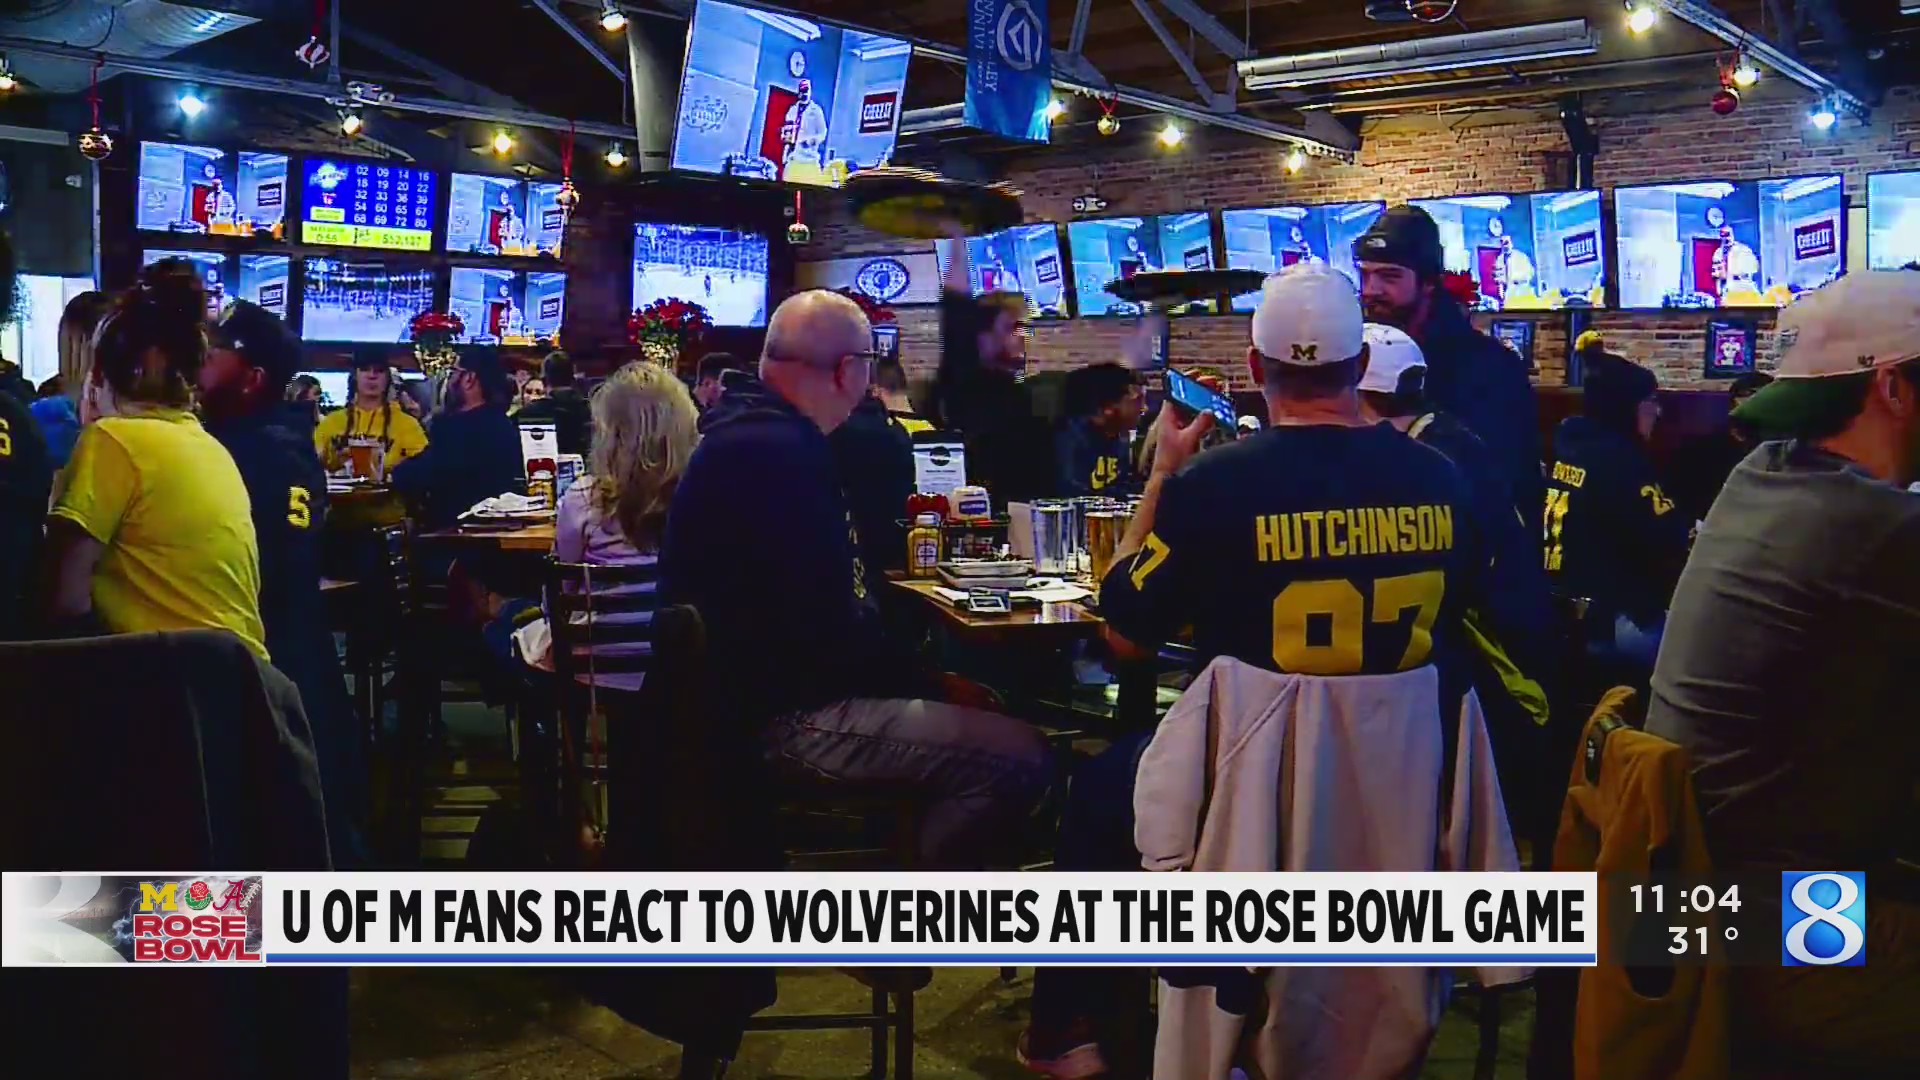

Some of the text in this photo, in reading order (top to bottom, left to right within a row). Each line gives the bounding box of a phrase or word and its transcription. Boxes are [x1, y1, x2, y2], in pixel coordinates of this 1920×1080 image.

[417, 183, 429, 193] 22
[354, 202, 367, 211] 54
[395, 204, 408, 215] 65
[415, 206, 428, 216] 67
[395, 216, 408, 226] 72
[1291, 343, 1318, 361] M
[1256, 506, 1454, 562] HUTCHINSON
